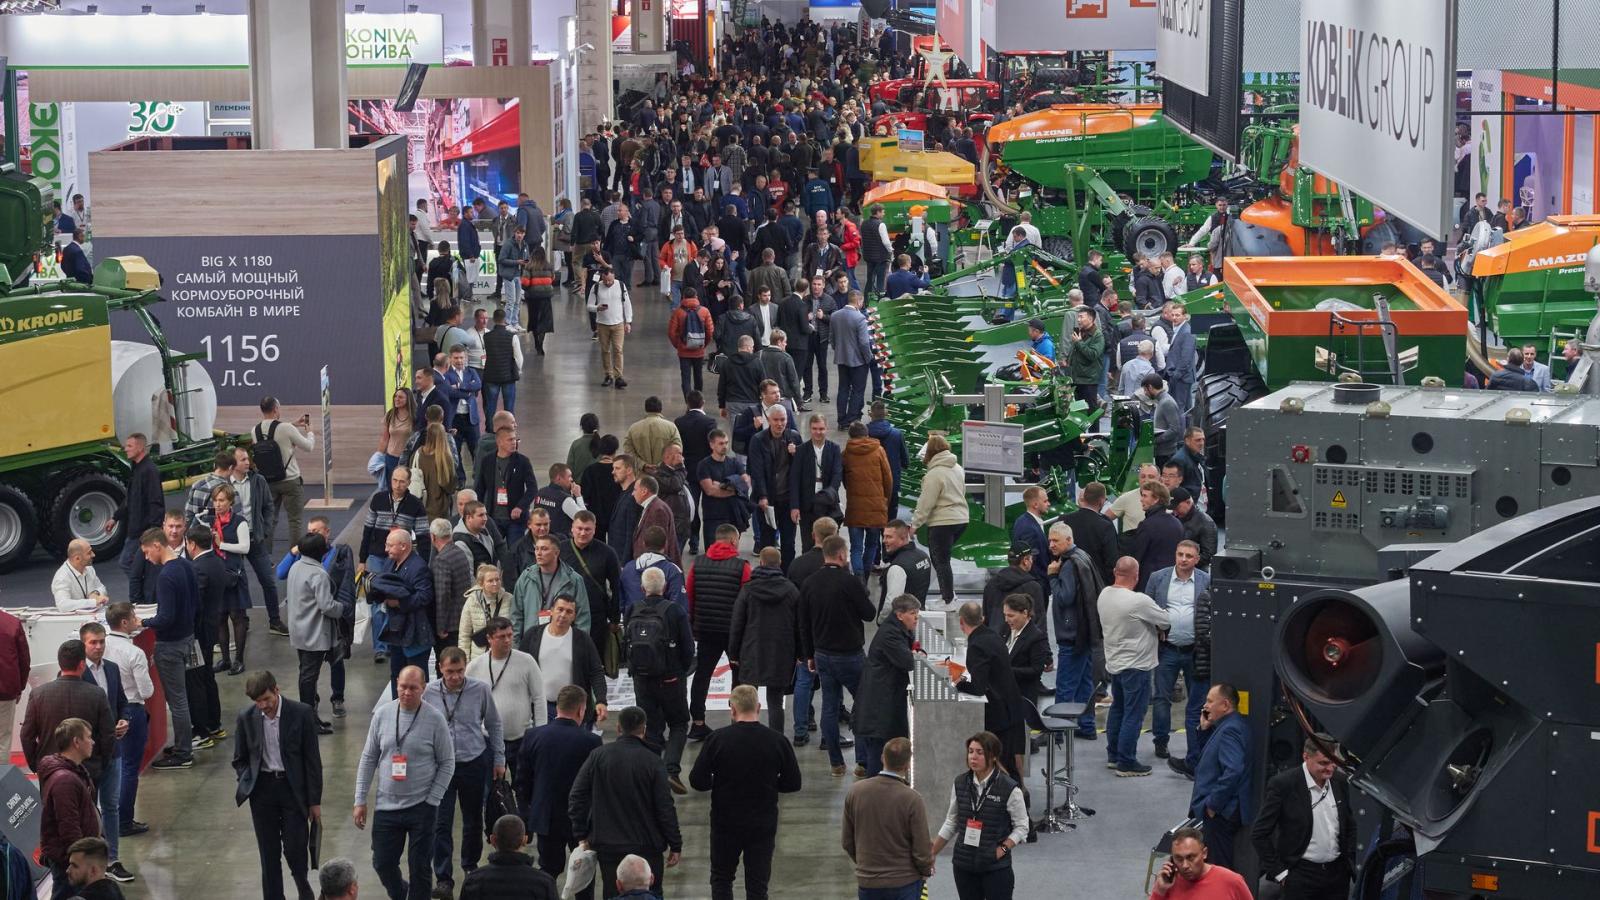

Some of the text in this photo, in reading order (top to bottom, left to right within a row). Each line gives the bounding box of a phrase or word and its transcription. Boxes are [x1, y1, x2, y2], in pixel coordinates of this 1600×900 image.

[1366, 31, 1434, 152] GROUP
[1019, 129, 1073, 139] AMAZONE
[201, 256, 223, 267] BIG
[243, 255, 272, 267] 1180
[176, 269, 299, 285] САМЫЙ МОЩНЫЙ
[171, 286, 304, 301] КОРМОУБОРОЧНЫЙ
[177, 304, 301, 318] КОМБАЙН В МИРЕ
[17, 308, 84, 332] KRONE
[199, 334, 280, 363] 1156
[220, 369, 262, 387] Л.С.
